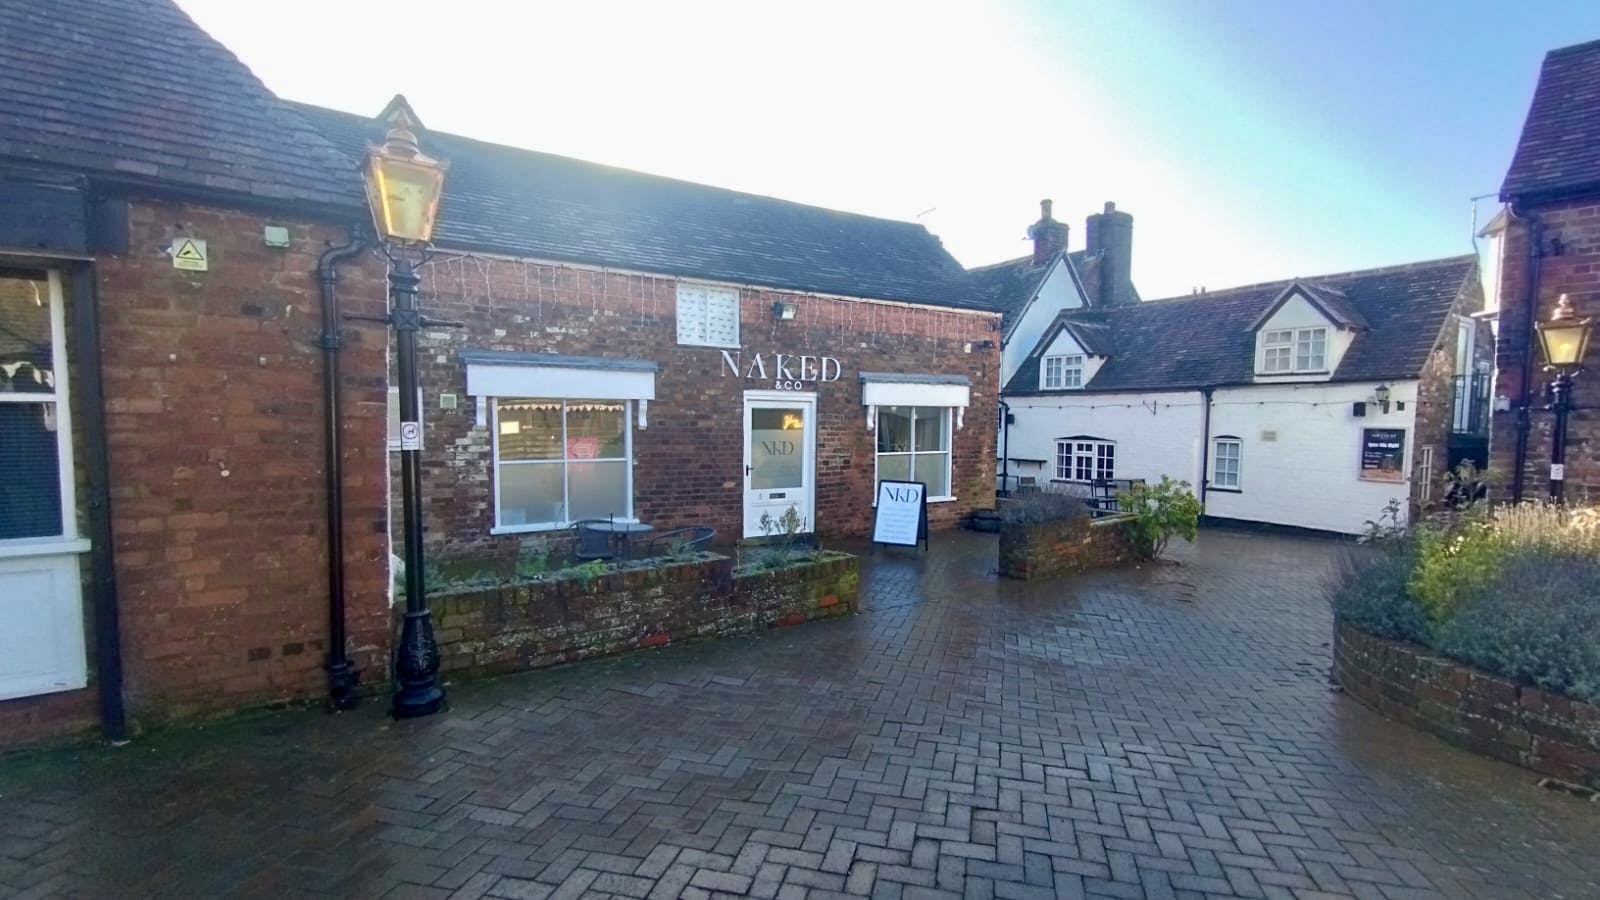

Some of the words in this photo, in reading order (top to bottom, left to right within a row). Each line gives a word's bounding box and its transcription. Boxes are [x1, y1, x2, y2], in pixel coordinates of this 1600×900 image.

[720, 350, 841, 382] NAKED
[775, 381, 802, 391] &CO
[762, 441, 794, 456] NKD
[885, 486, 919, 503] NKD
